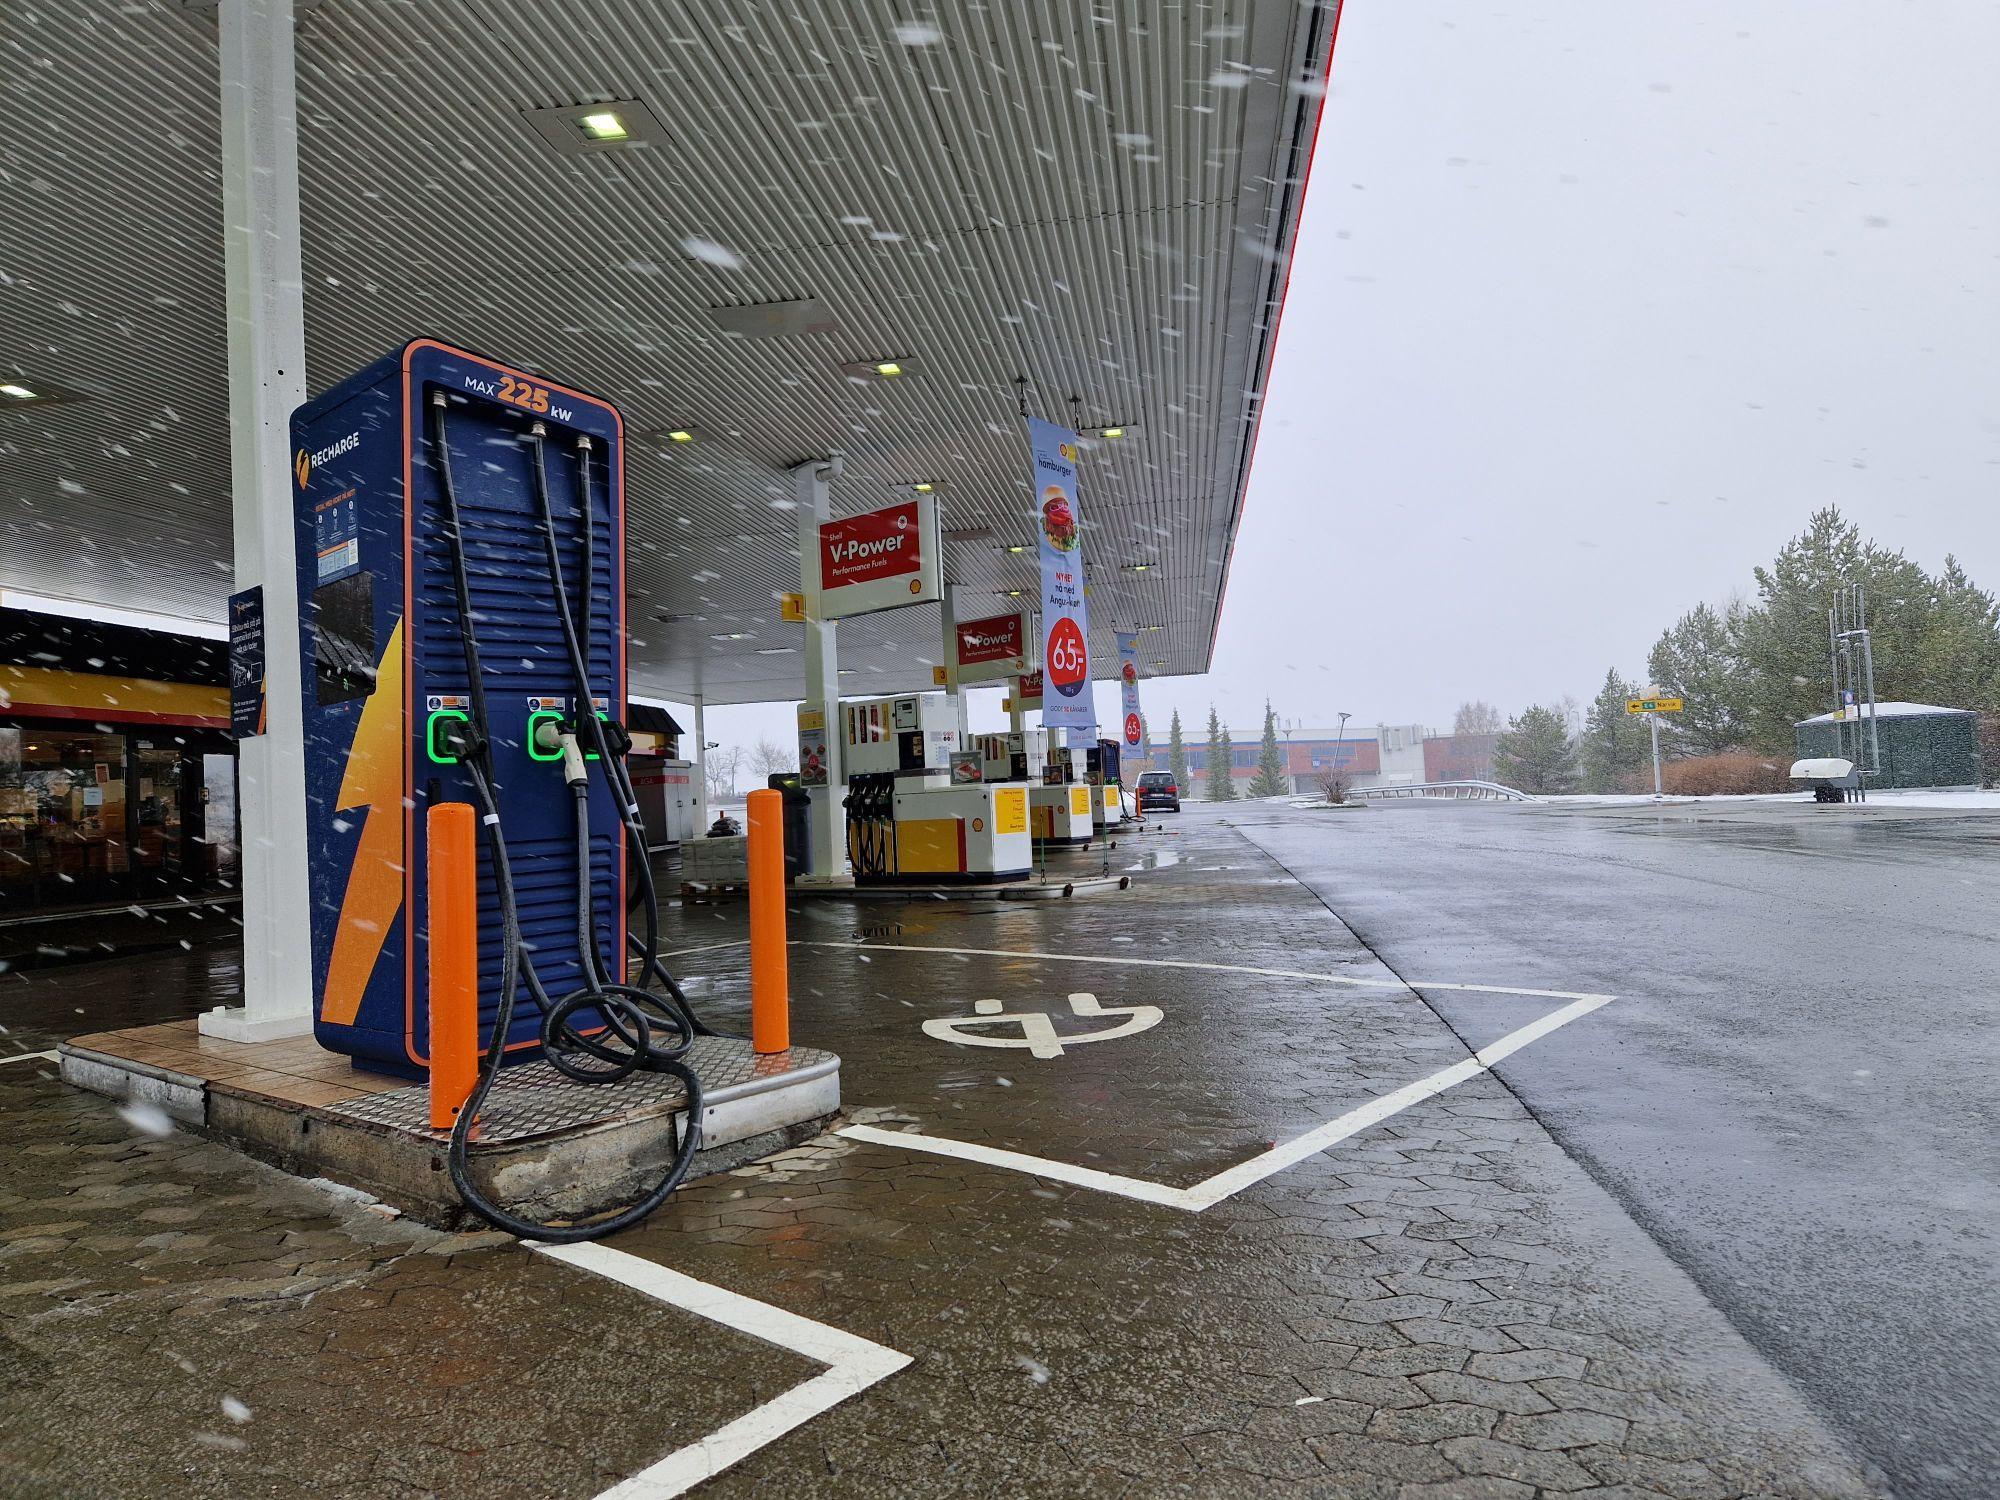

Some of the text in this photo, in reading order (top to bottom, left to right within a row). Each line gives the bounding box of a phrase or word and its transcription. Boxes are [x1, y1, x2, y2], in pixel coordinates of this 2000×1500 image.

[464, 376, 572, 421] MAX 225 kW
[311, 431, 360, 469] RECHARGE
[1038, 456, 1071, 477] hamburger
[829, 531, 843, 542] Shell
[830, 534, 905, 563] V-Power
[832, 558, 888, 577] Performance Fuels
[794, 600, 800, 614] 1
[940, 670, 946, 680] 3
[1657, 701, 1676, 709] Narvik
